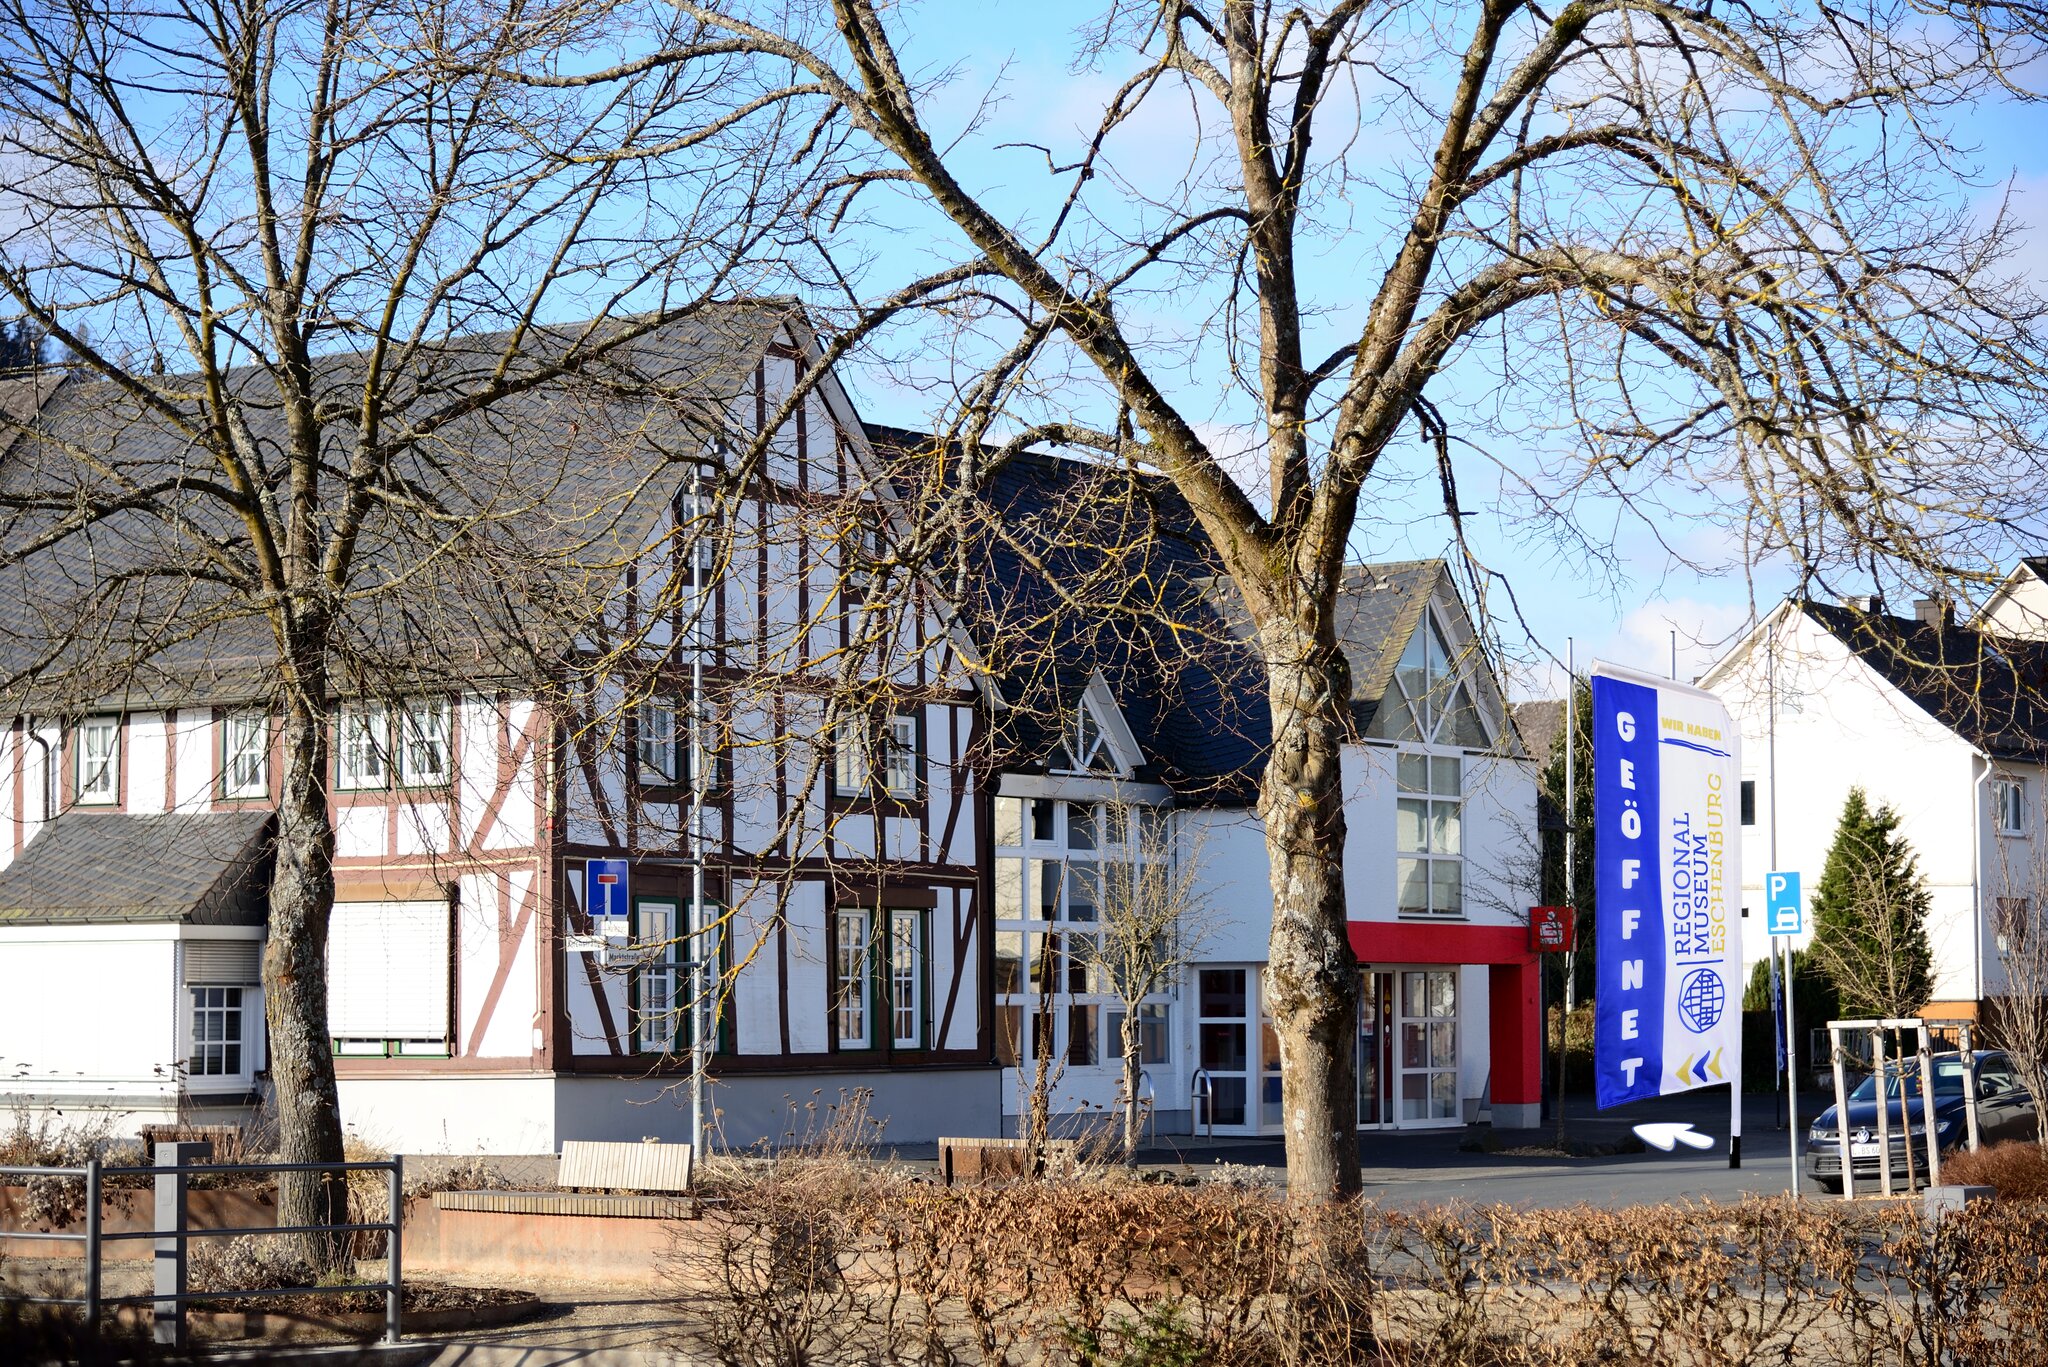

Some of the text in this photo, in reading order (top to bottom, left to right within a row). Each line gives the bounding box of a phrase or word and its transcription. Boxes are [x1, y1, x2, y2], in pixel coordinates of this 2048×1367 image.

[1661, 717, 1722, 742] WIR HABEN
[1616, 711, 1644, 1088] GEÖFFNET
[1673, 812, 1691, 956] REGIONAL
[1692, 834, 1710, 955] MUSEUM
[1707, 773, 1726, 953] ESCHENBURG
[1771, 875, 1787, 902] P
